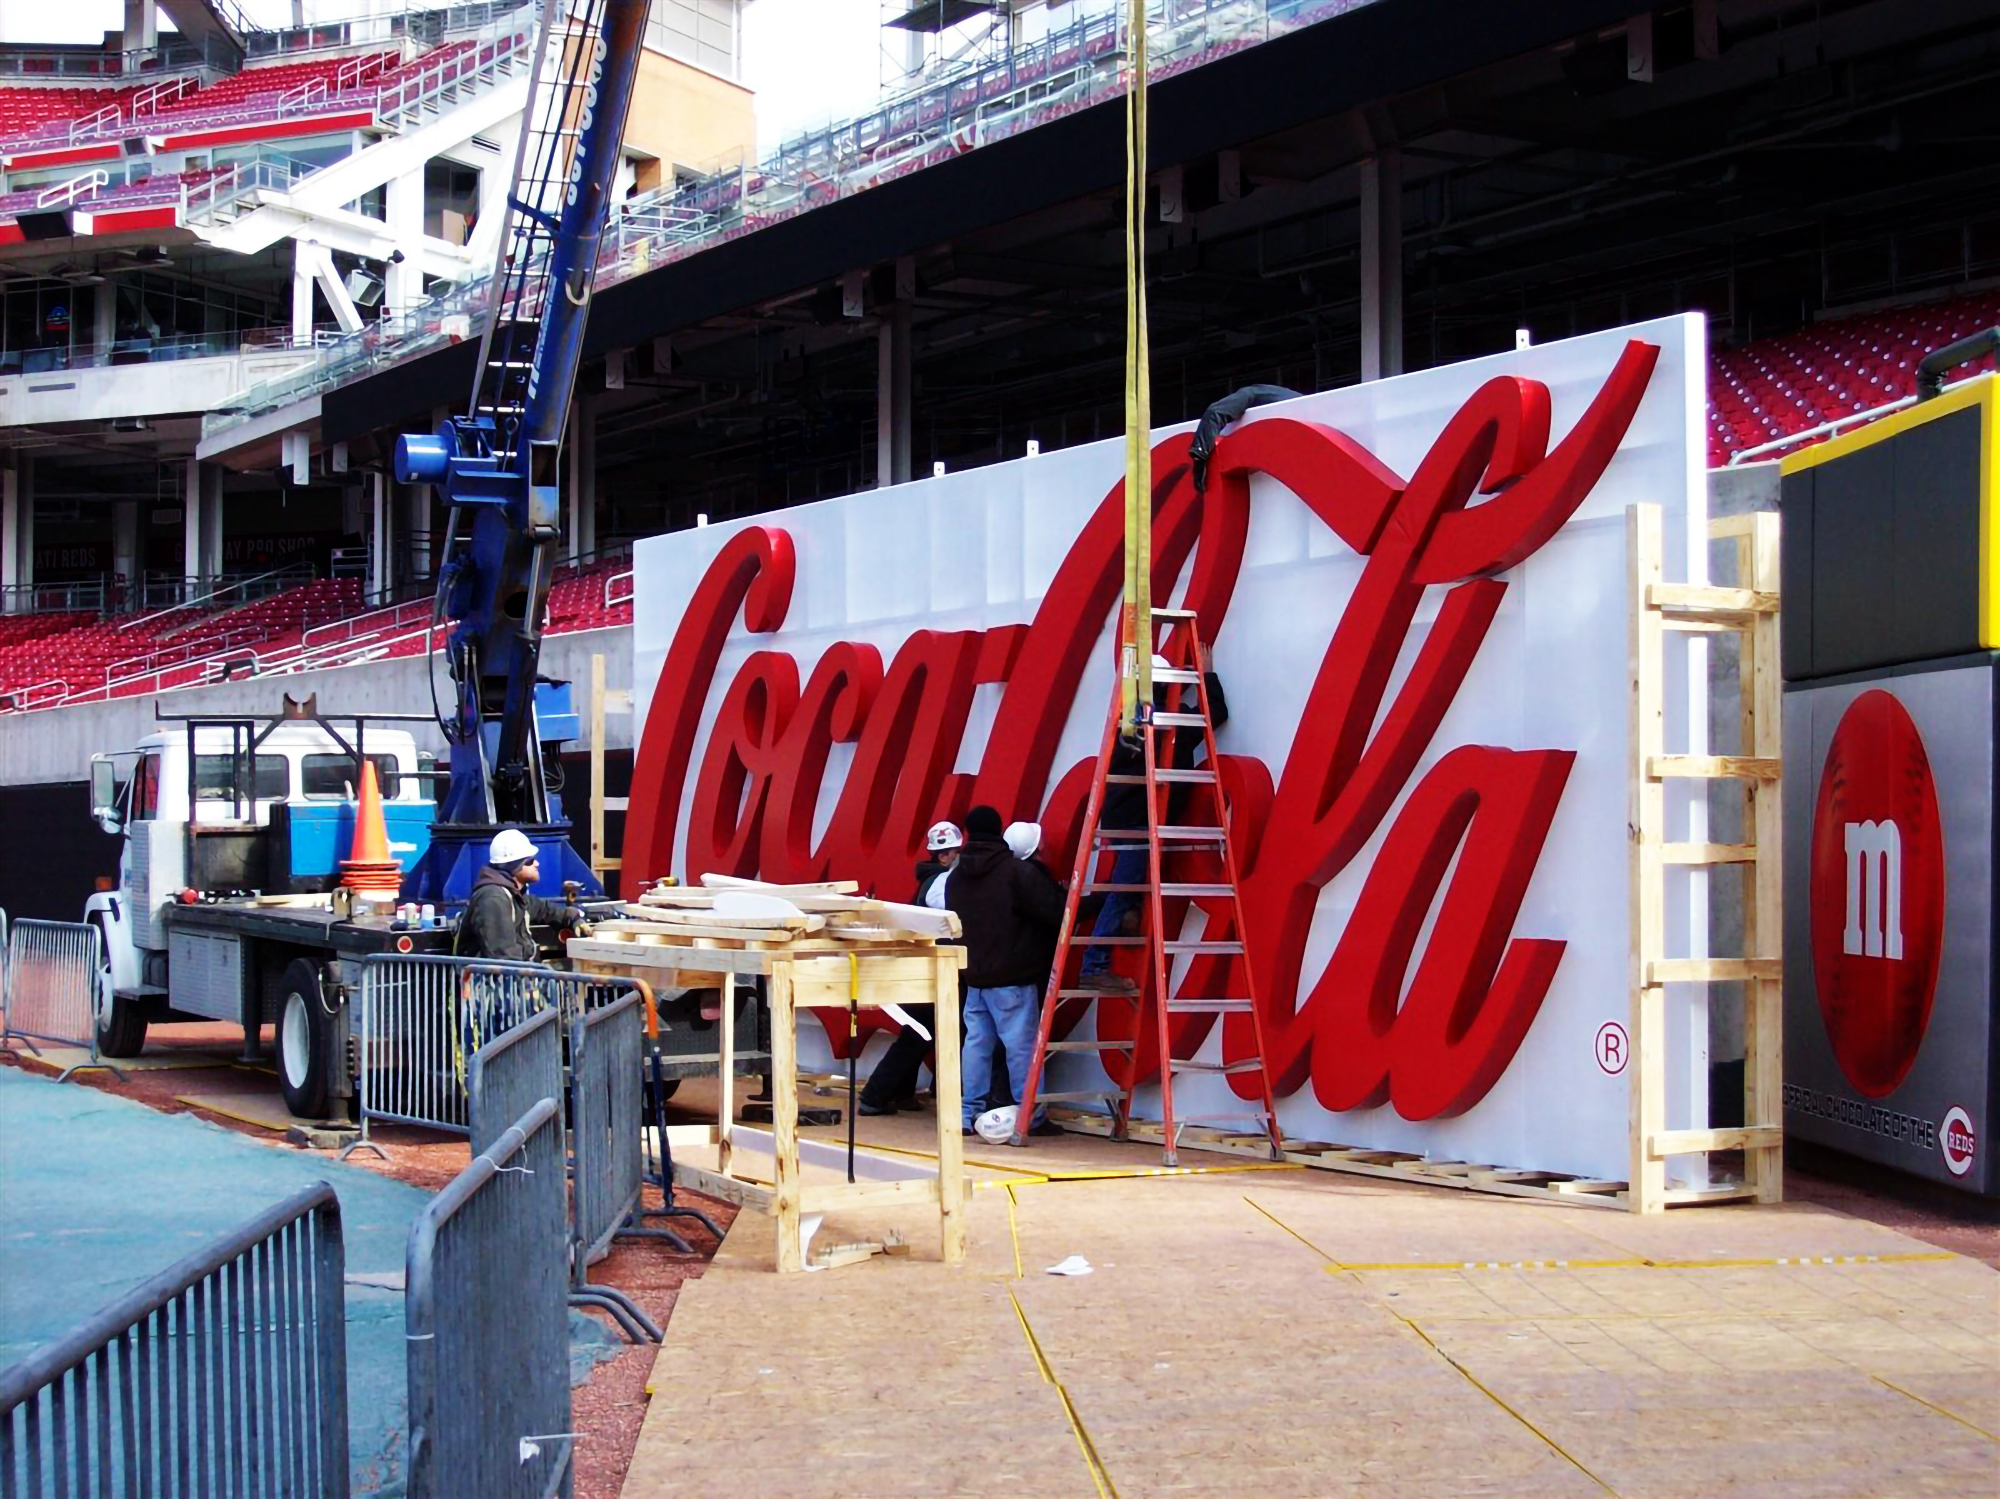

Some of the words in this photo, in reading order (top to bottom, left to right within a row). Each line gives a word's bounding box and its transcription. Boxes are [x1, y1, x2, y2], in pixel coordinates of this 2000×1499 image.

[1826, 1093, 1890, 1137] CHOCOLATE
[1892, 1111, 1908, 1141] OF
[1909, 1117, 1936, 1151] THE
[1948, 1131, 1975, 1155] REDS
